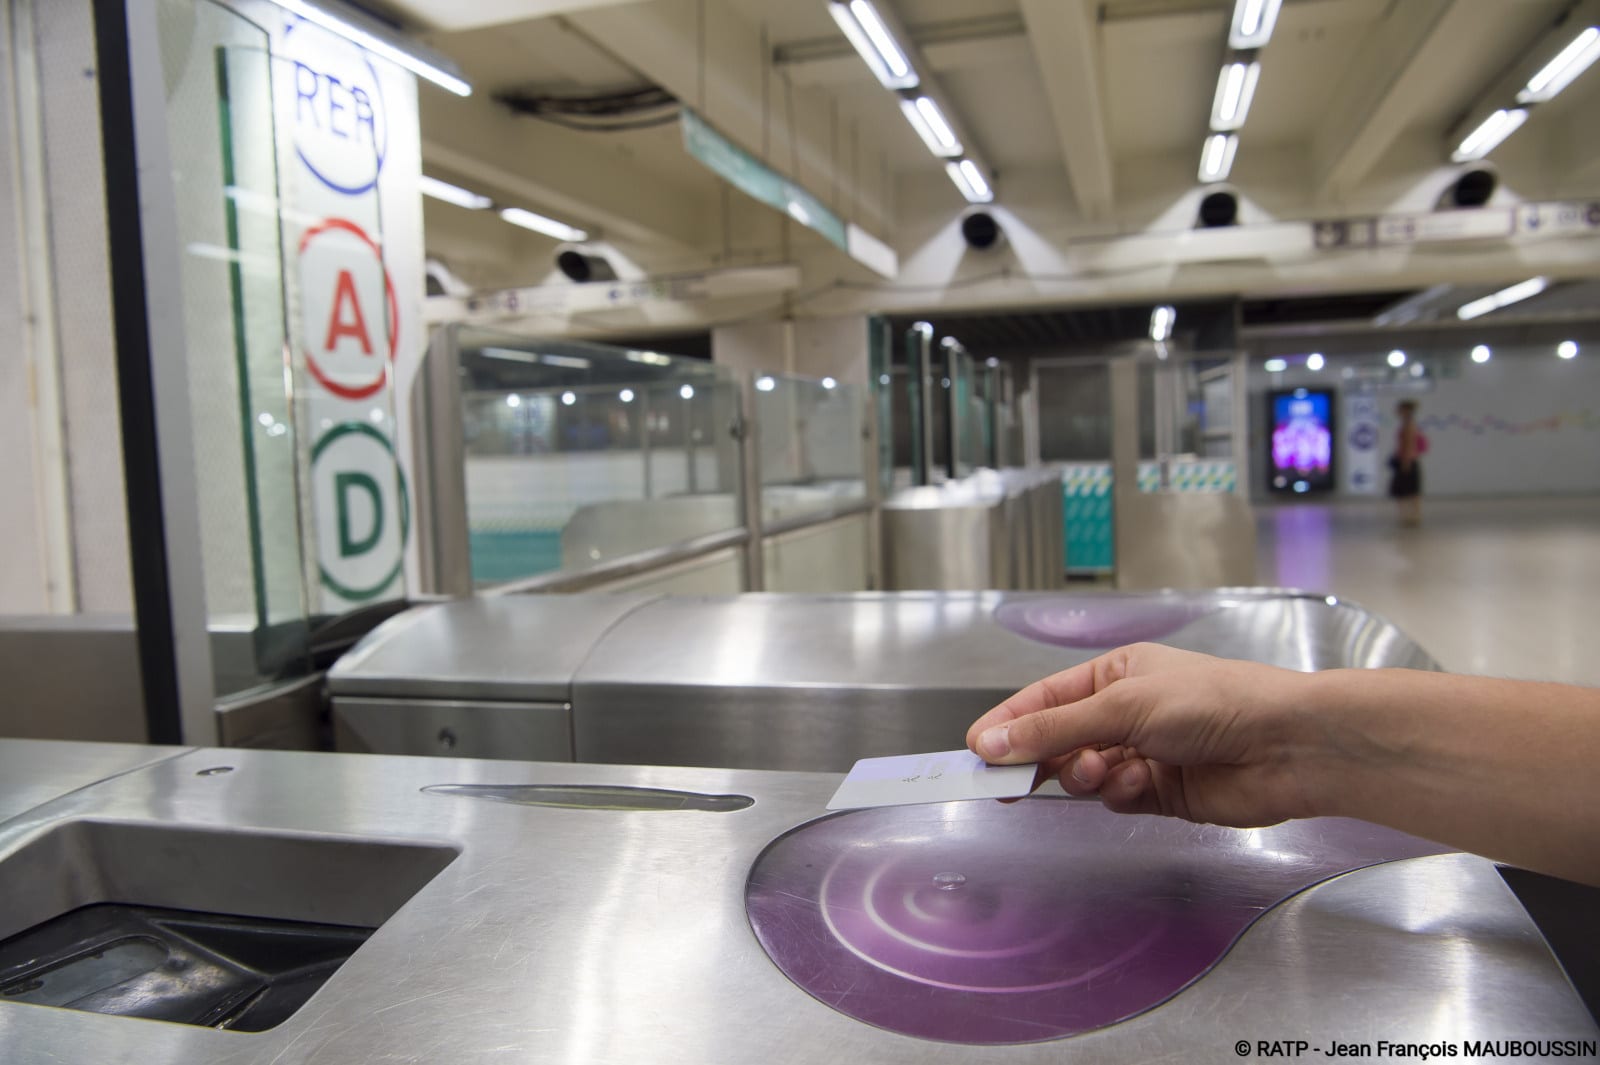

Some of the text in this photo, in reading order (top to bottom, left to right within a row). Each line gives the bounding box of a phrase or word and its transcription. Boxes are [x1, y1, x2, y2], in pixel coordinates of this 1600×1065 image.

[294, 60, 375, 143] RER
[325, 269, 374, 356] A
[335, 472, 383, 559] D
